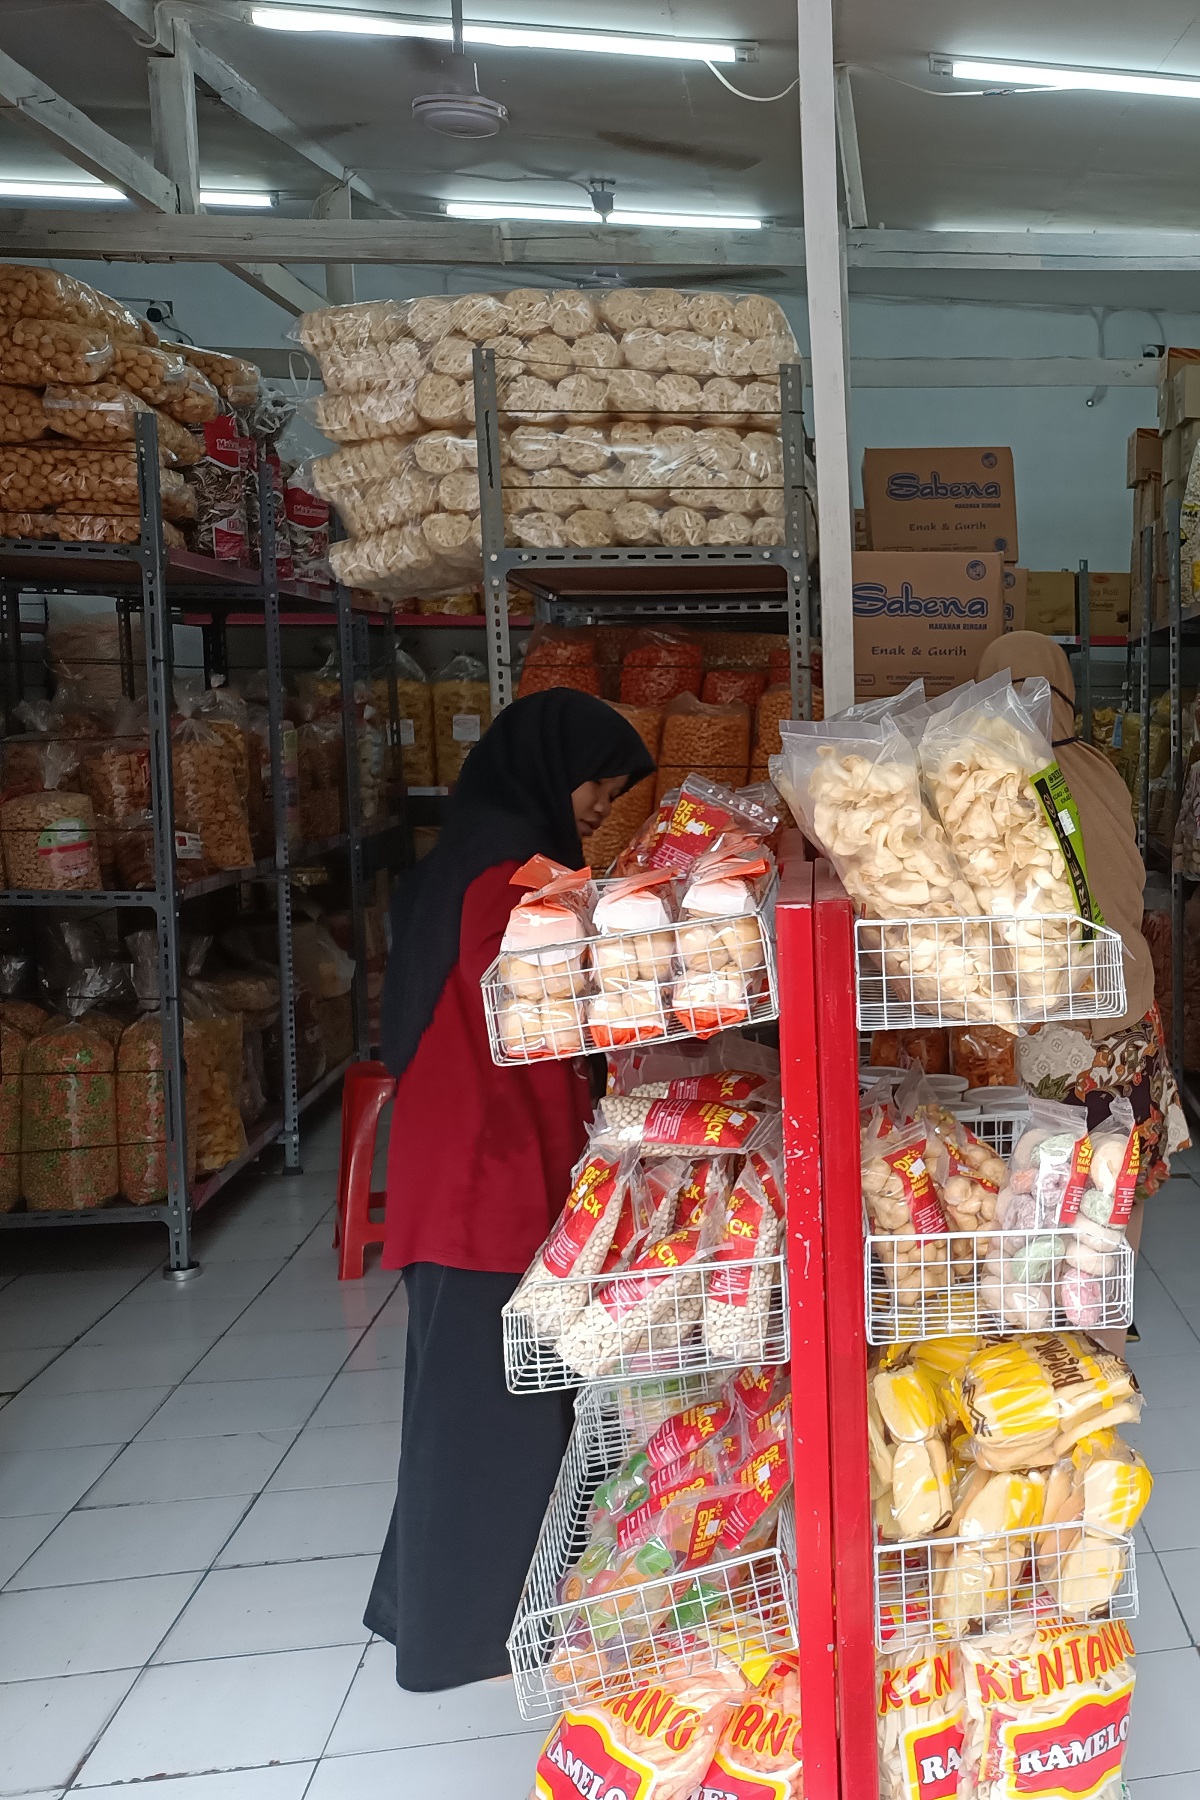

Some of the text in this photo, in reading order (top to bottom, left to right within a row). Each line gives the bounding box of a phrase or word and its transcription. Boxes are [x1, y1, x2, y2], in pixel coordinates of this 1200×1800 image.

[886, 471, 1001, 501] Sabena
[909, 521, 986, 532] Enak & Gurih
[852, 582, 988, 618] Sabena
[871, 645, 967, 657] Enak & Gurih
[678, 800, 697, 814] DE
[697, 1509, 714, 1527] DE
[975, 1619, 1136, 1705] KENTANG
[1019, 1714, 1130, 1775] RAMELO
